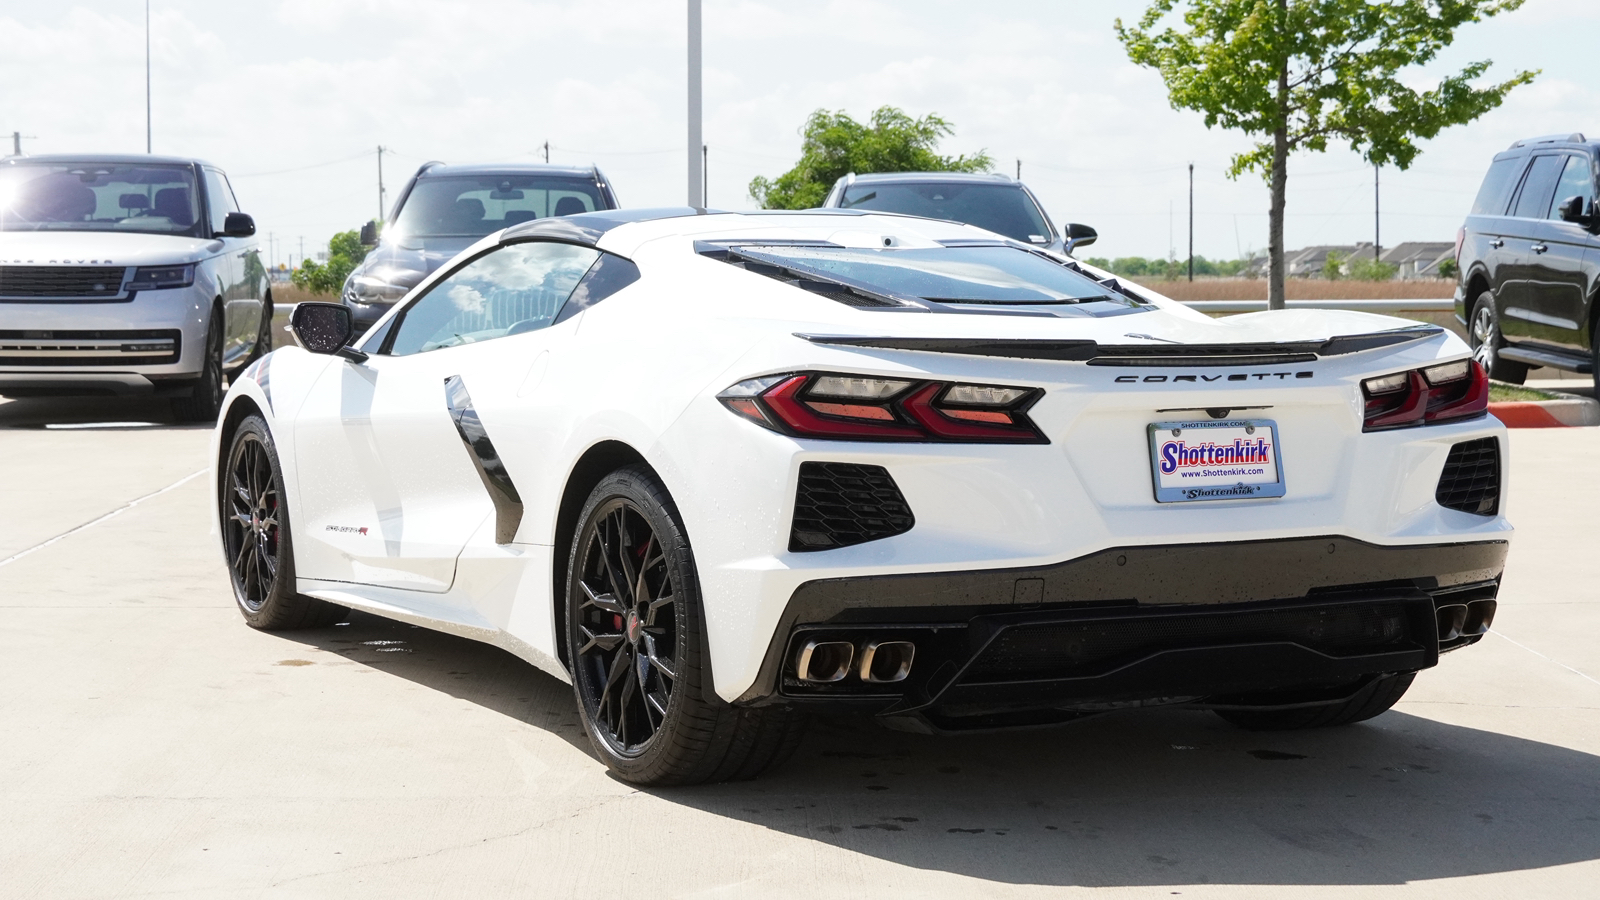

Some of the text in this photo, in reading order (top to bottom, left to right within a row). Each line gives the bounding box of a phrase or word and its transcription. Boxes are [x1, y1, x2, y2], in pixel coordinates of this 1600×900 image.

[1114, 371, 1314, 383] CORVETTE
[1161, 439, 1269, 474] Shottenkirk
[1181, 467, 1264, 478] www.Shottenkirk.com
[1187, 484, 1254, 499] Shottenkirk
